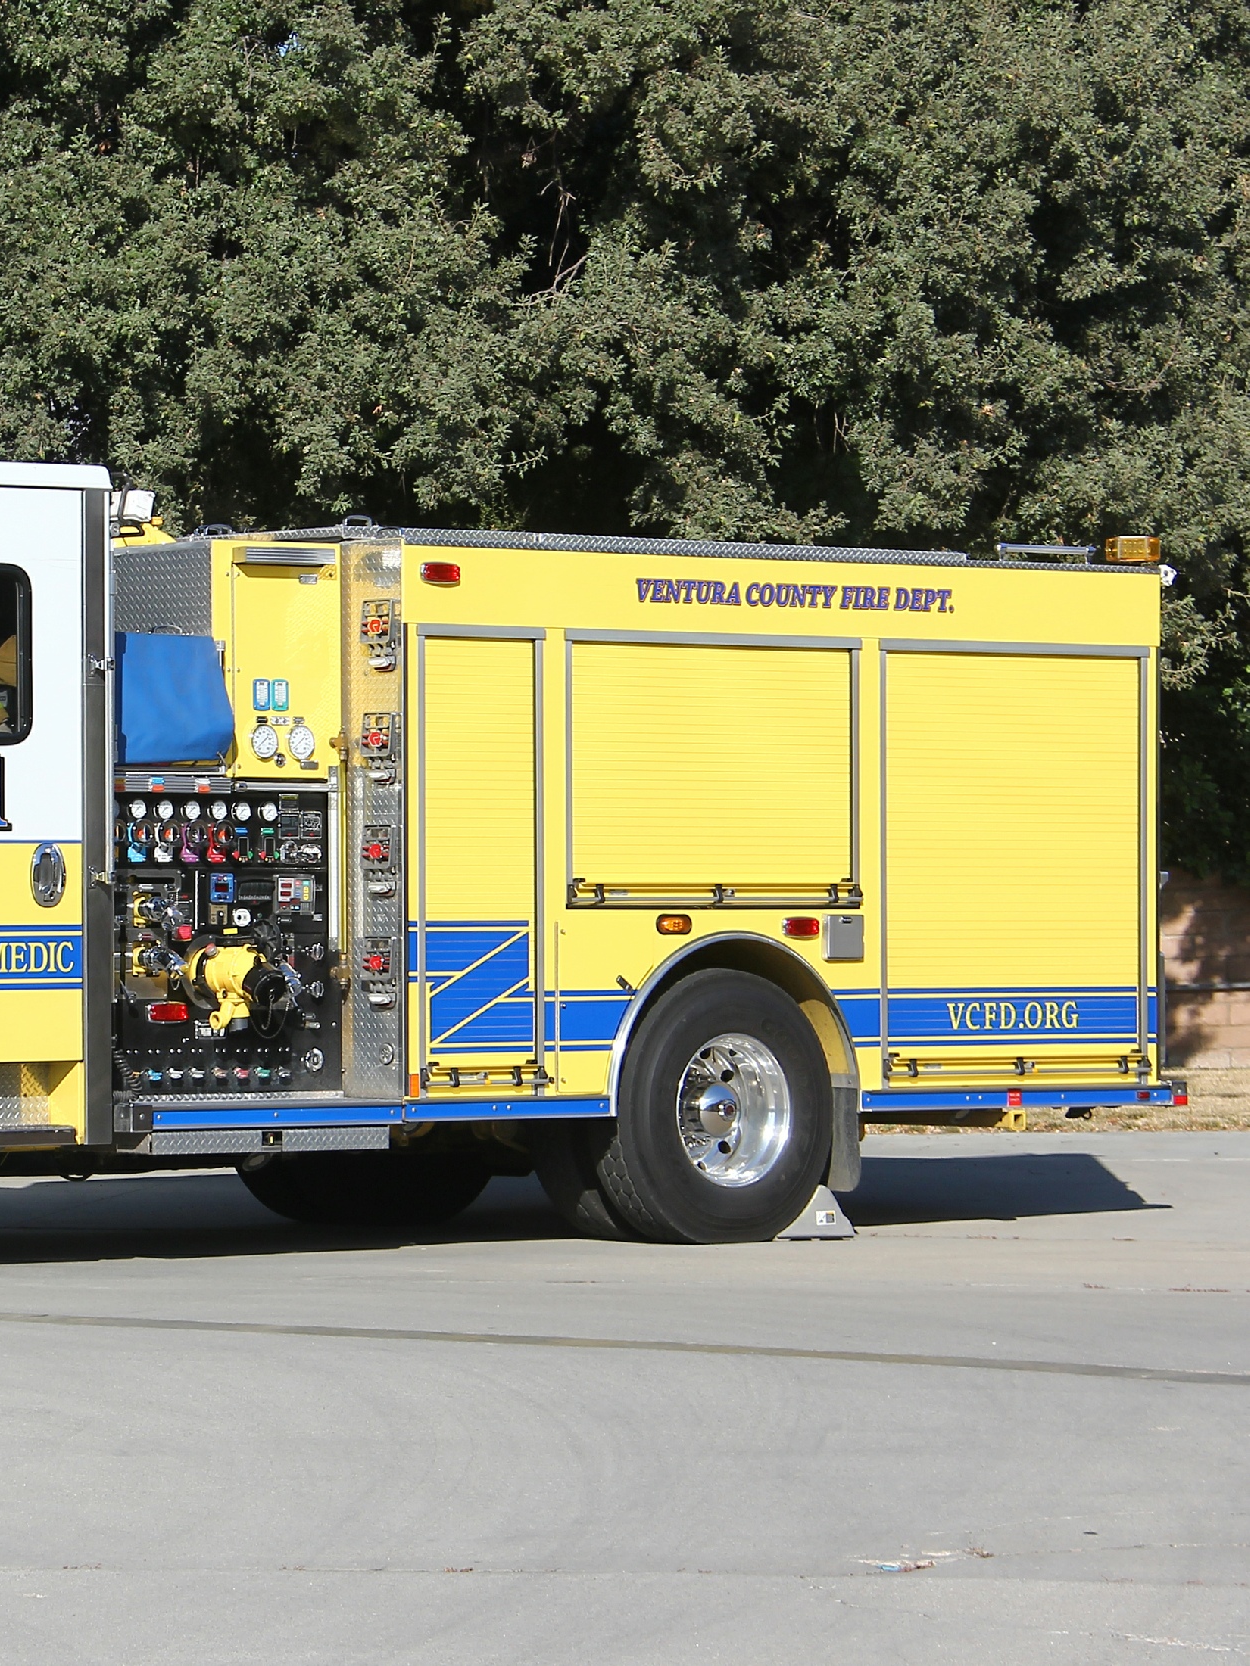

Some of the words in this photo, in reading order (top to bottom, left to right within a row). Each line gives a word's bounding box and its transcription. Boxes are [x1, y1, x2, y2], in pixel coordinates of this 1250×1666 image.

[636, 577, 742, 606] VENTURA
[744, 582, 837, 608] COUNTY
[839, 585, 891, 610] FIRE
[893, 588, 955, 613] DEPT.
[946, 1001, 1080, 1031] VCFD.ORG
